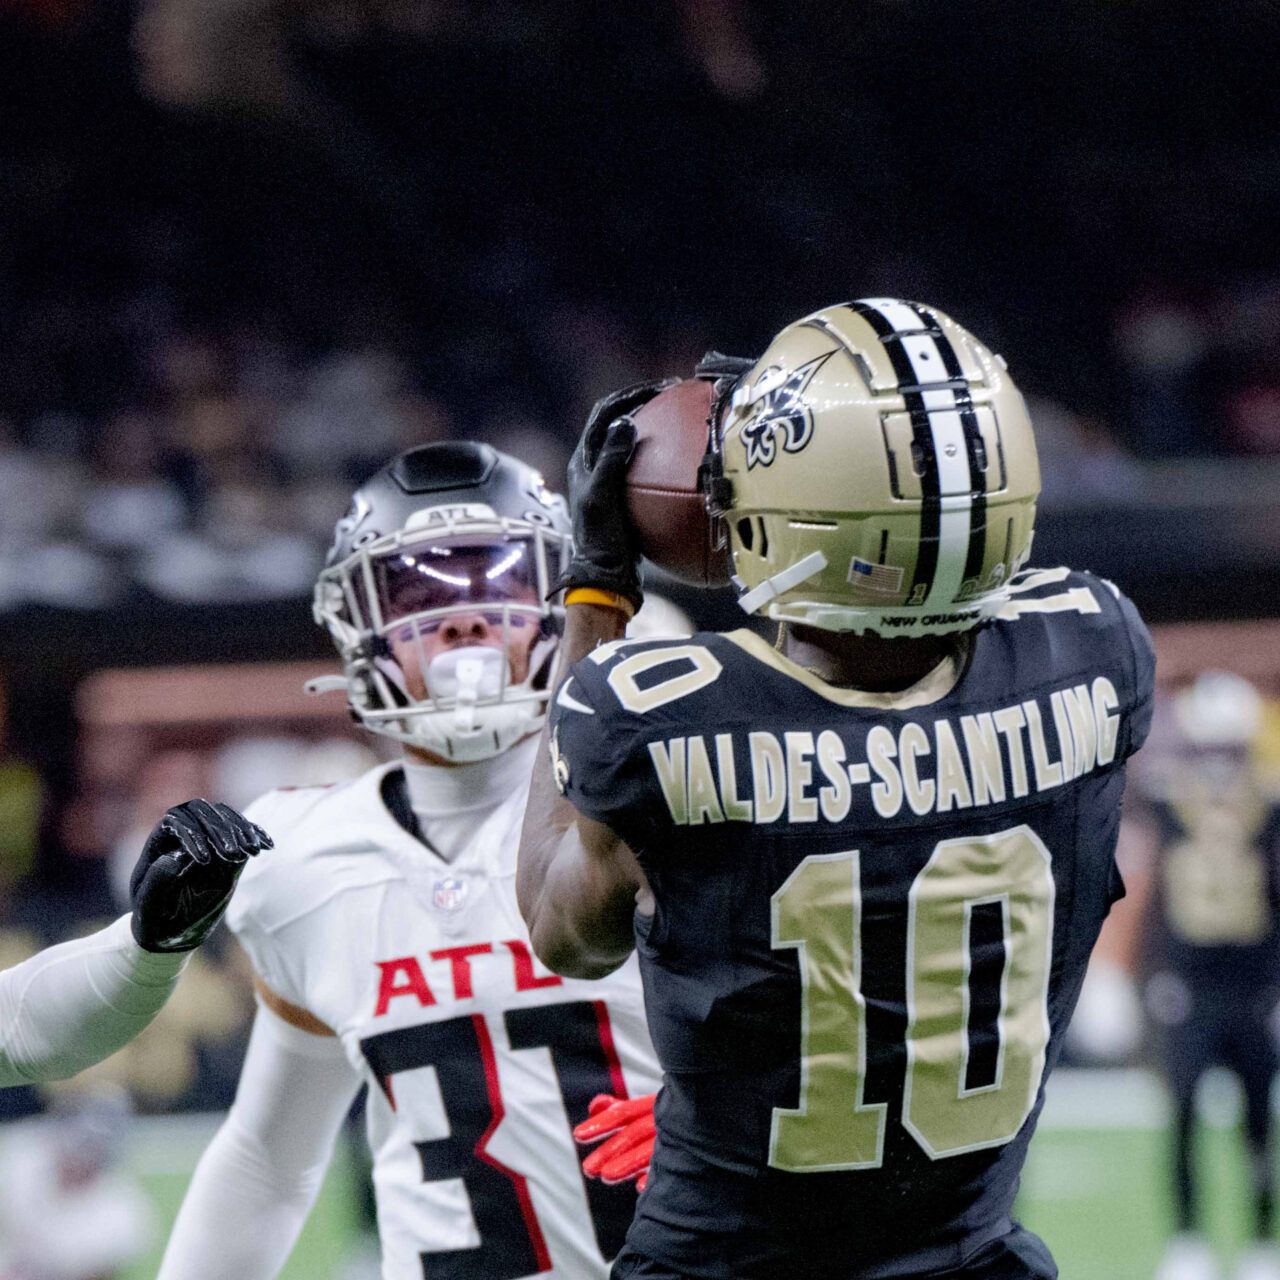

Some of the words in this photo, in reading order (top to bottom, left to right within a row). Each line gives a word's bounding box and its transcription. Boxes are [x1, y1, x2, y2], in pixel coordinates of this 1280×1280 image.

[428, 507, 475, 524] ATL
[649, 677, 1120, 825] VALDES-SCANTLING
[374, 940, 563, 1017] ATL
[768, 824, 1056, 1173] 10
